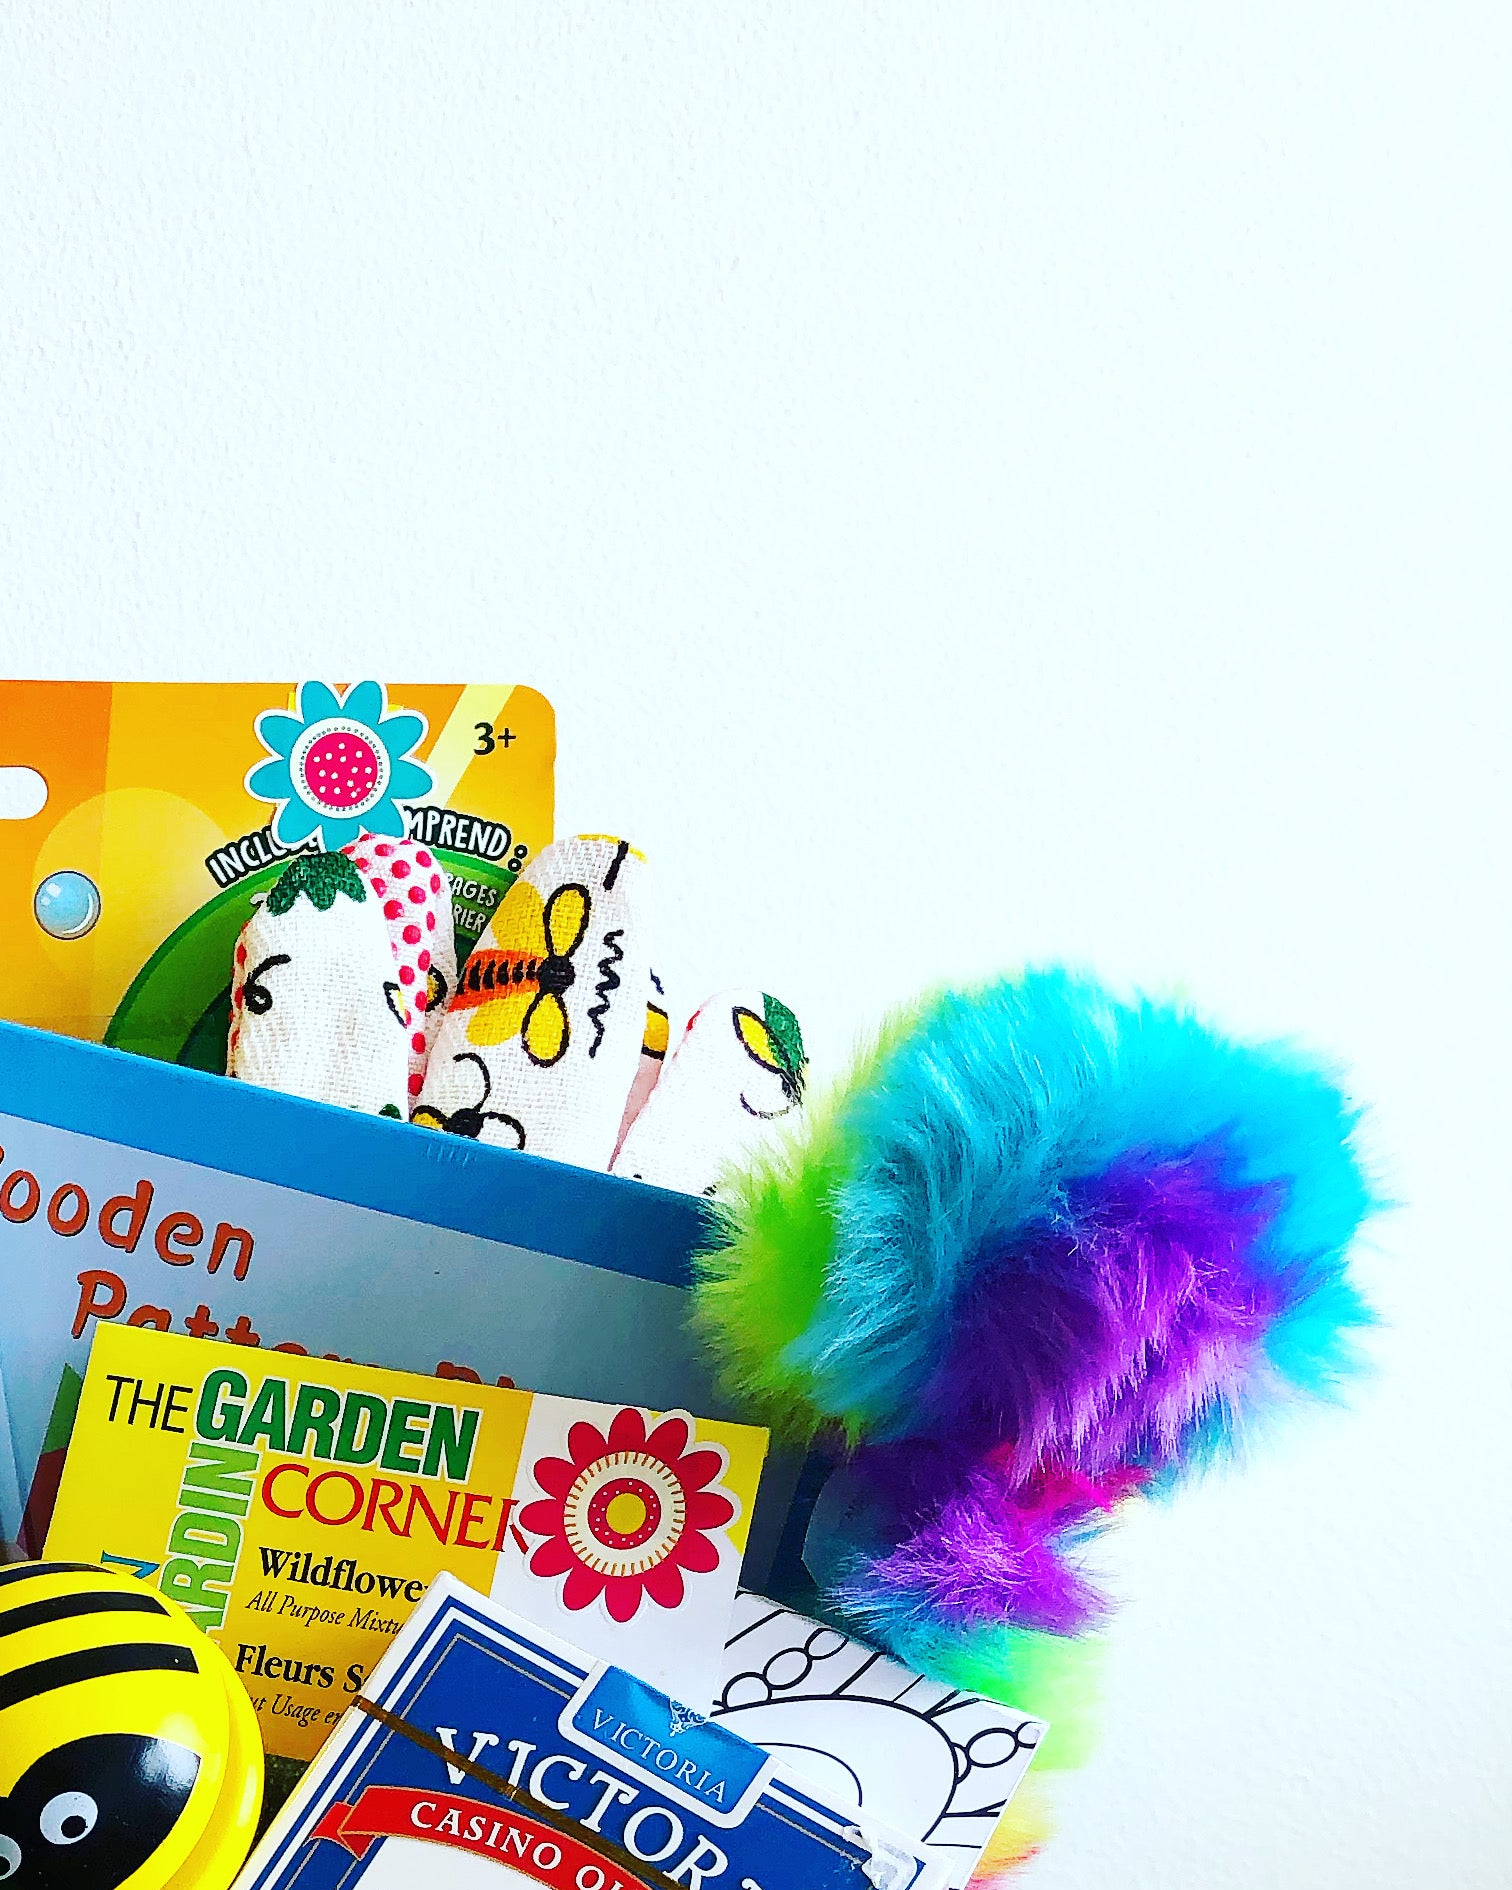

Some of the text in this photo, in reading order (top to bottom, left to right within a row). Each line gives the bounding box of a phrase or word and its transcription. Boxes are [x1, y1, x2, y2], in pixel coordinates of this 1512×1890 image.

[473, 722, 516, 755] 3+
[106, 1369, 480, 1480] THE GARDEN
[245, 1591, 277, 1612] All
[277, 1595, 345, 1627] Purpose
[236, 1644, 334, 1688] Fleurs
[272, 1694, 320, 1727] Usage
[592, 1709, 726, 1804] VICTORIA
[409, 1802, 562, 1871] CASINO
